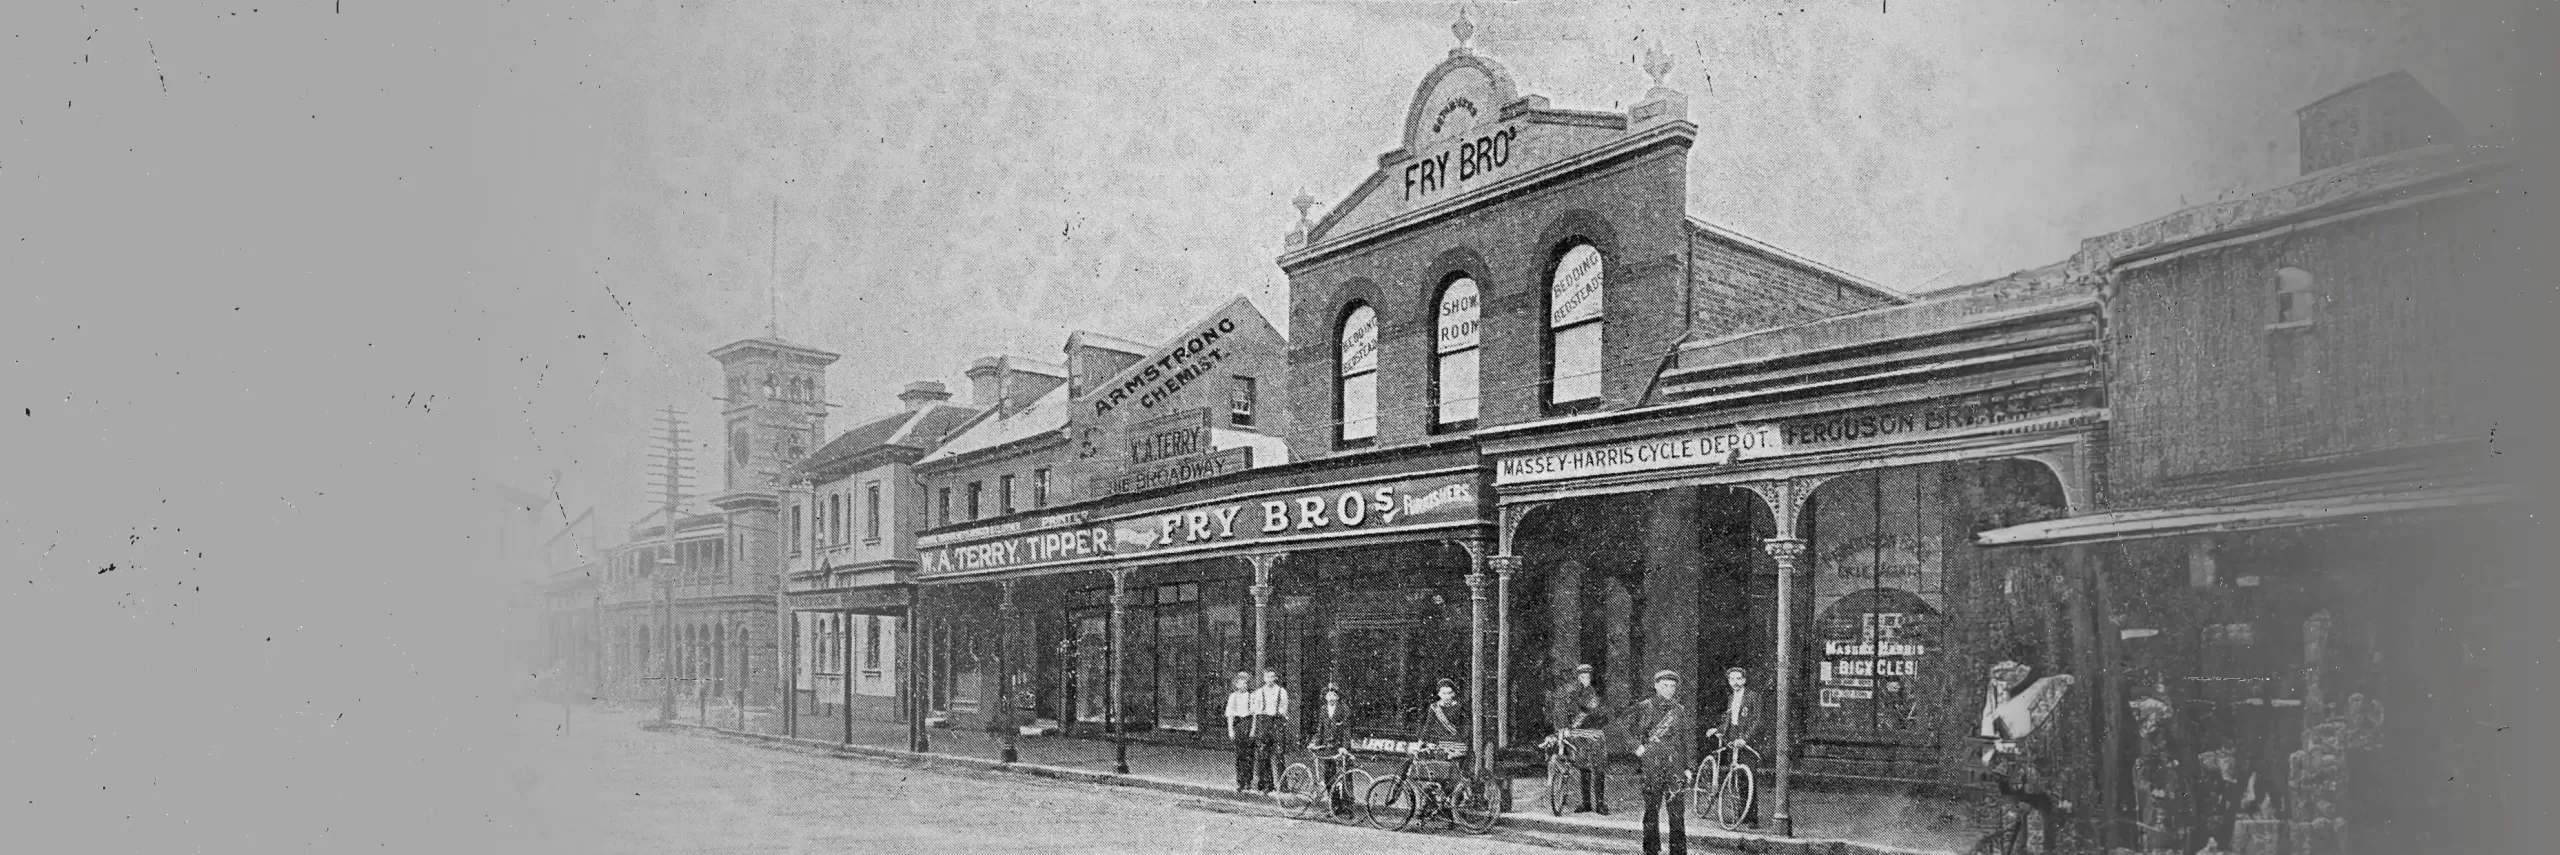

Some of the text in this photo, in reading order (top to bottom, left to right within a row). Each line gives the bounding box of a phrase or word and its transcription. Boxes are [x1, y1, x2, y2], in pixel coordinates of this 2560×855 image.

[1405, 151, 1449, 201] FRY
[1554, 251, 1598, 299] BEDDING
[1443, 294, 1479, 316] SHOW
[1442, 320, 1479, 341] ROOM
[1095, 318, 1235, 416] ARMSTRONG
[1157, 426, 1200, 459] TERRY
[1788, 412, 1914, 445] FERGUSON
[1137, 459, 1224, 489] BROADWAY
[1504, 446, 1634, 476] MASSEY-HARRIS
[1638, 439, 1694, 462] CYCLE
[1159, 506, 1242, 545] FRY
[1839, 659, 1914, 676] BICYCLES
